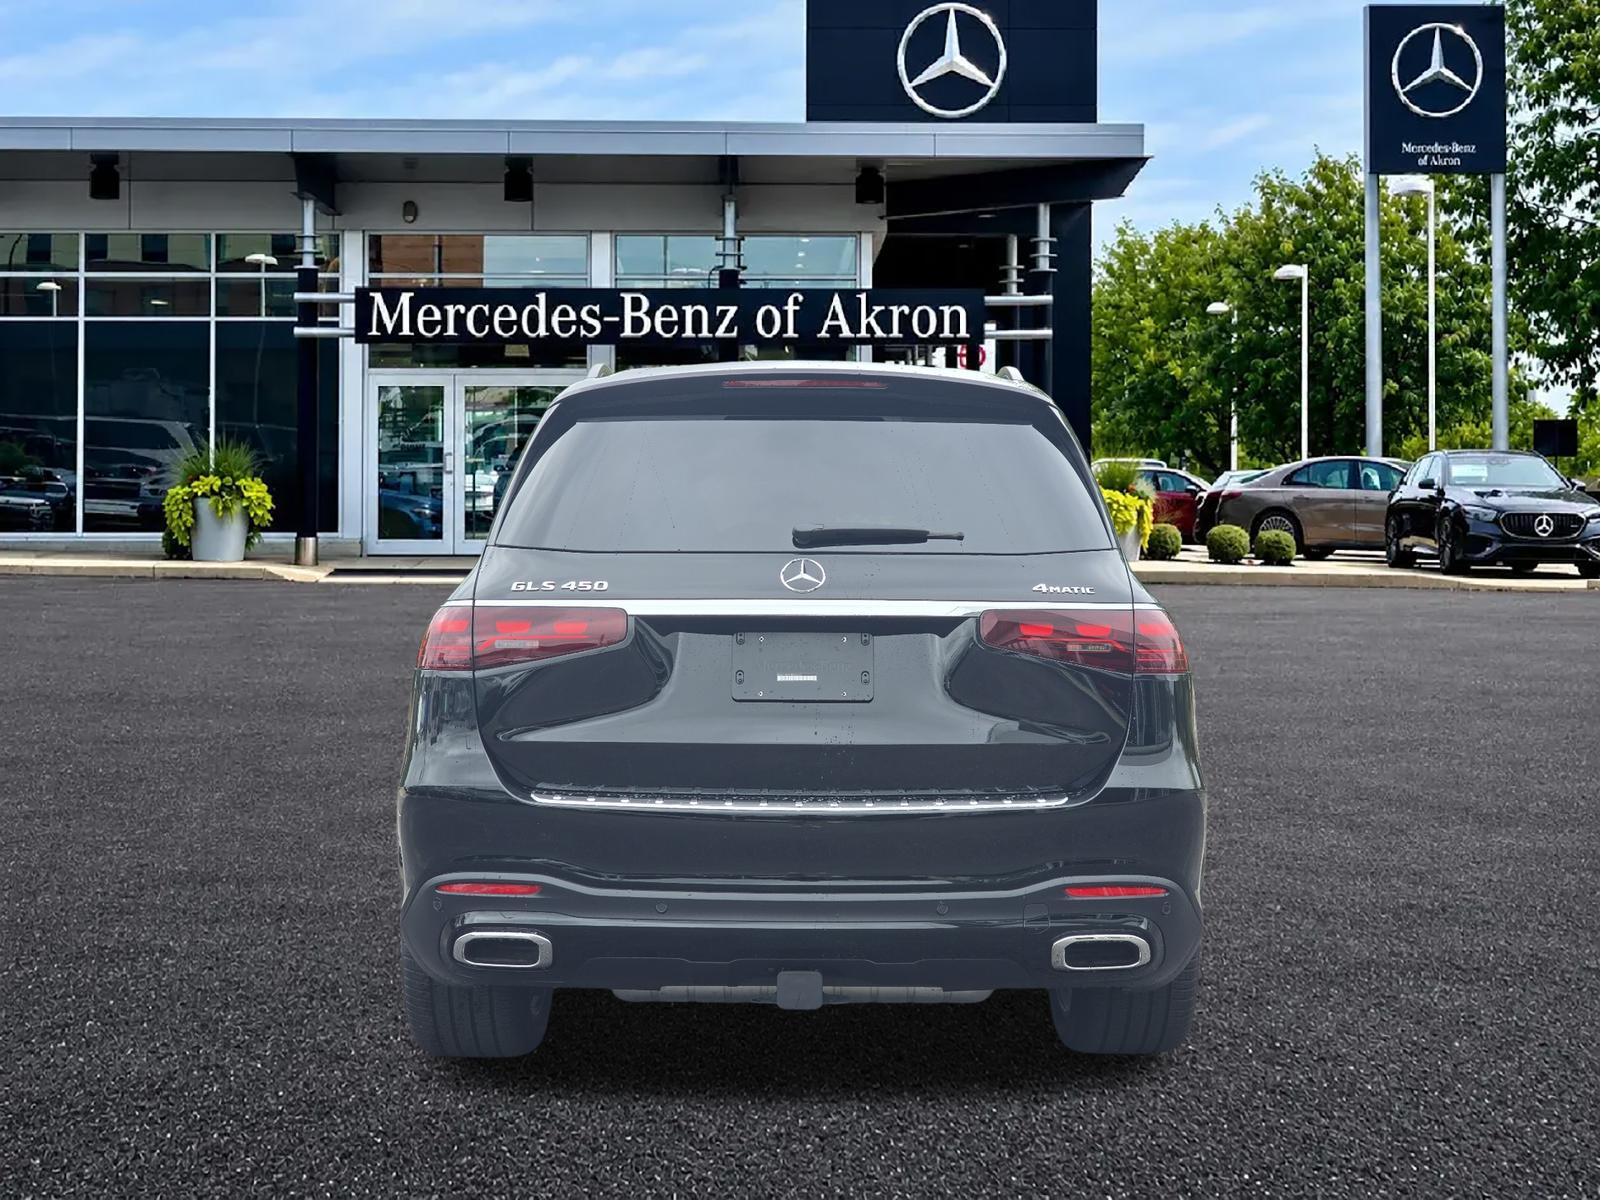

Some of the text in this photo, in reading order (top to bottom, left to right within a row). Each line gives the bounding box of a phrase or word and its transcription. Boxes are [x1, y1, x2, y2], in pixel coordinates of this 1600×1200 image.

[1401, 141, 1476, 154] Mercedes-Benz
[1417, 154, 1461, 166] of Akron
[367, 291, 970, 339] Mercedes-Benz of Akron
[510, 580, 609, 592] GLS 450
[1032, 583, 1096, 594] 4MATIC
